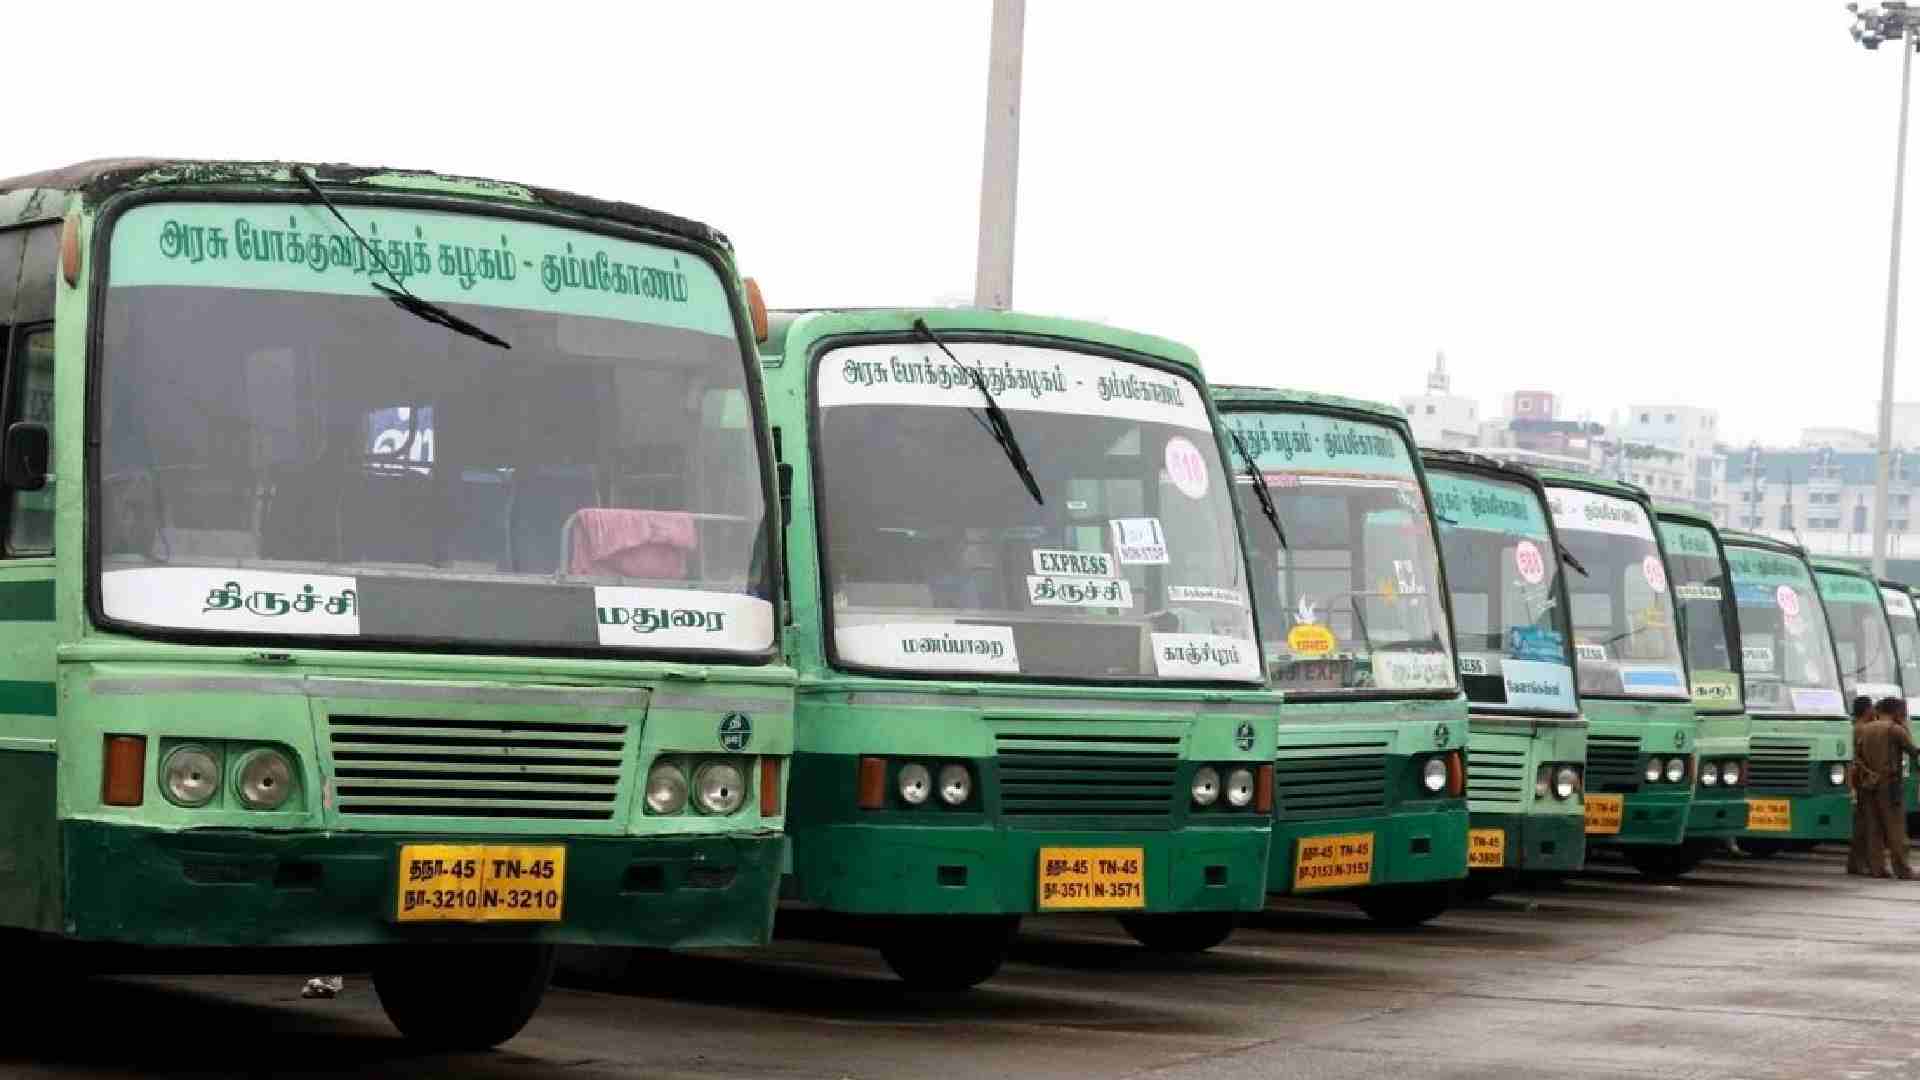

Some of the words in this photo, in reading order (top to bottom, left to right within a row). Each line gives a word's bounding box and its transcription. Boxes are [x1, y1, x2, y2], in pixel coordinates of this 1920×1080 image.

[159, 219, 228, 264] அரசு
[438, 234, 517, 290] கழகம்
[541, 242, 688, 302] கும்பகோணம்
[842, 359, 888, 386] அரசு
[1040, 553, 1108, 574] EXPRESS
[202, 581, 357, 616] திருச்சி
[1032, 578, 1121, 603] திருச்சி
[597, 607, 727, 633] மதுரை
[492, 859, 555, 879] TN-45
[1098, 859, 1138, 874] TN-45
[482, 888, 558, 909] N-3210
[1094, 882, 1140, 897] N-3571
